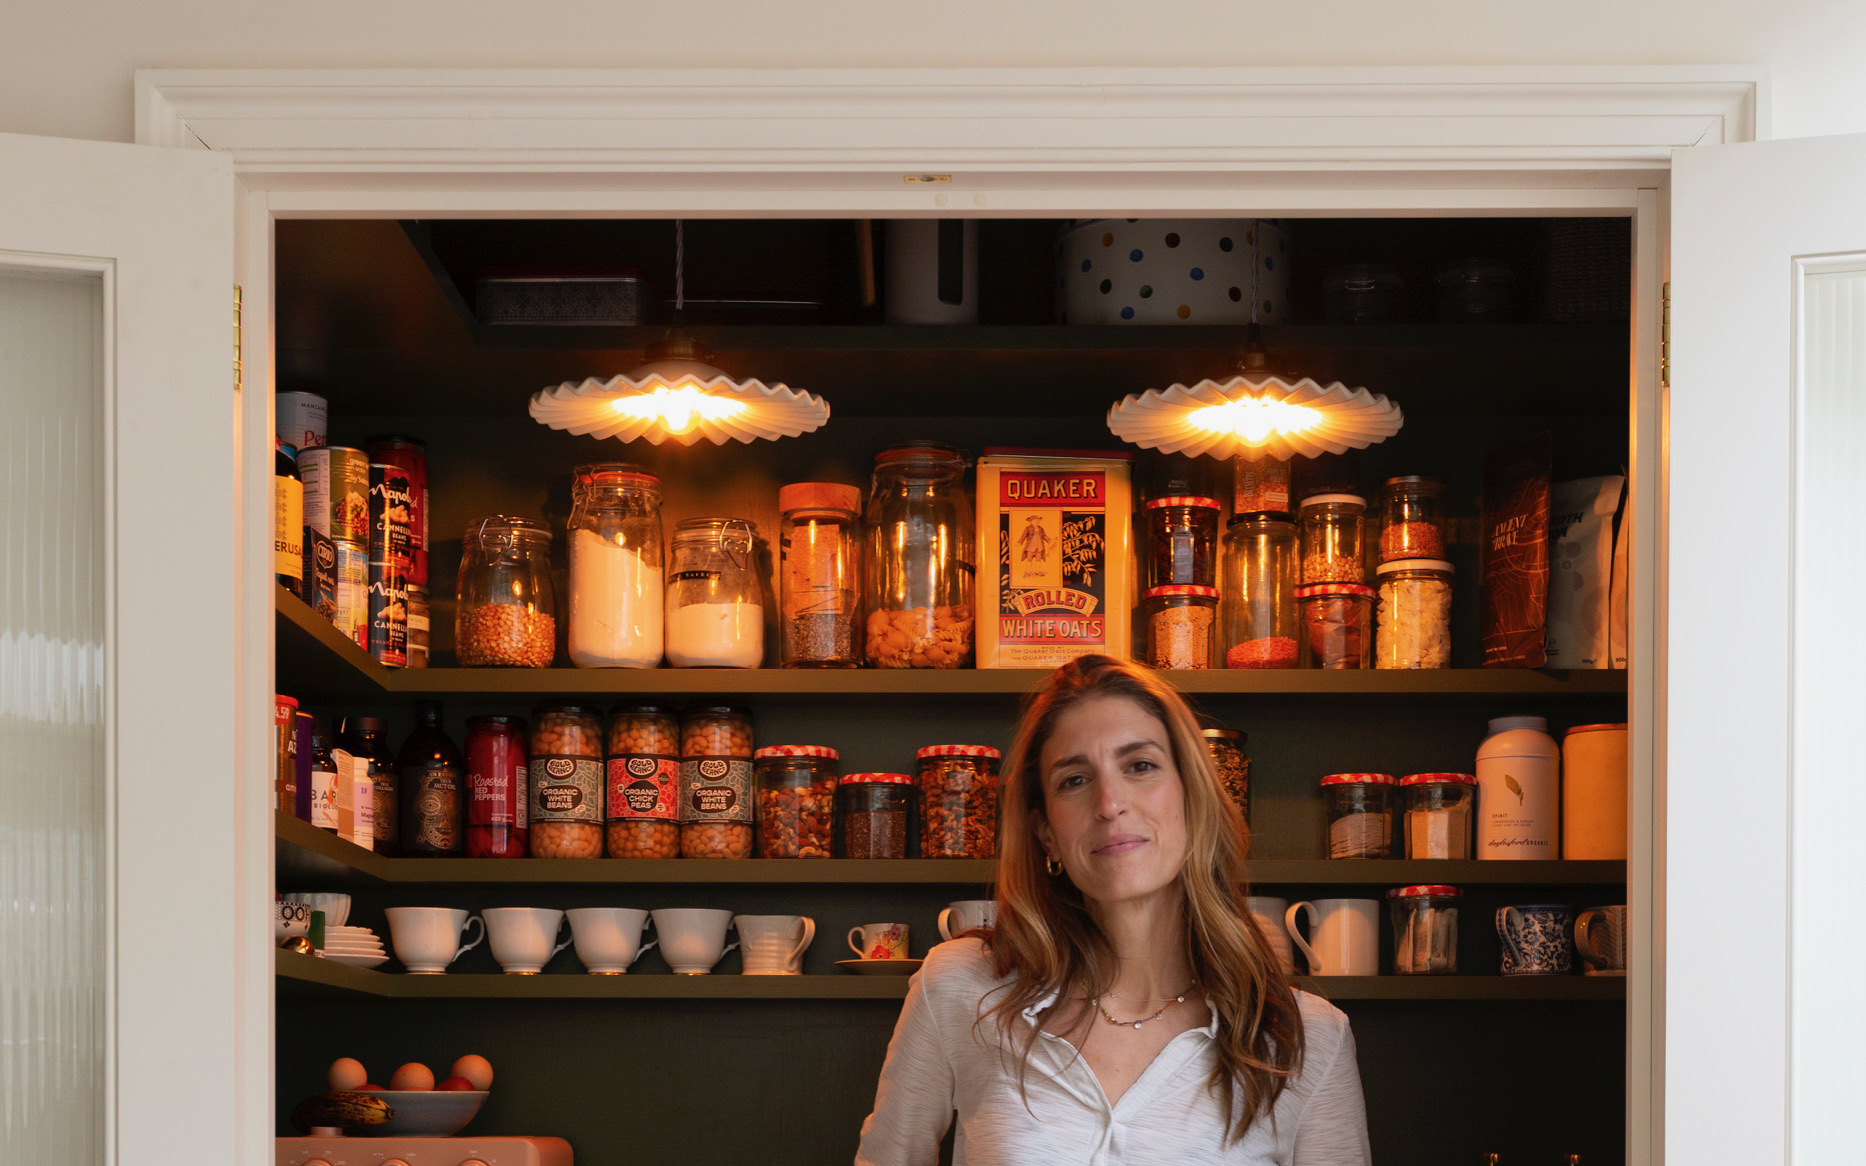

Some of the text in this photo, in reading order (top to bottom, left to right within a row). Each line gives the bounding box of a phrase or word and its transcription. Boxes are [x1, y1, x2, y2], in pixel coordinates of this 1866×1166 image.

[1007, 479, 1098, 500] QUAKER
[1022, 590, 1087, 610] ROLLED
[1002, 620, 1103, 638] WHITE OATS
[473, 774, 508, 787] Roasted
[475, 793, 506, 801] PEPPERS
[542, 788, 578, 796] ORGANIC
[624, 788, 659, 796] ORGANIC
[696, 789, 732, 797] ORGANIC
